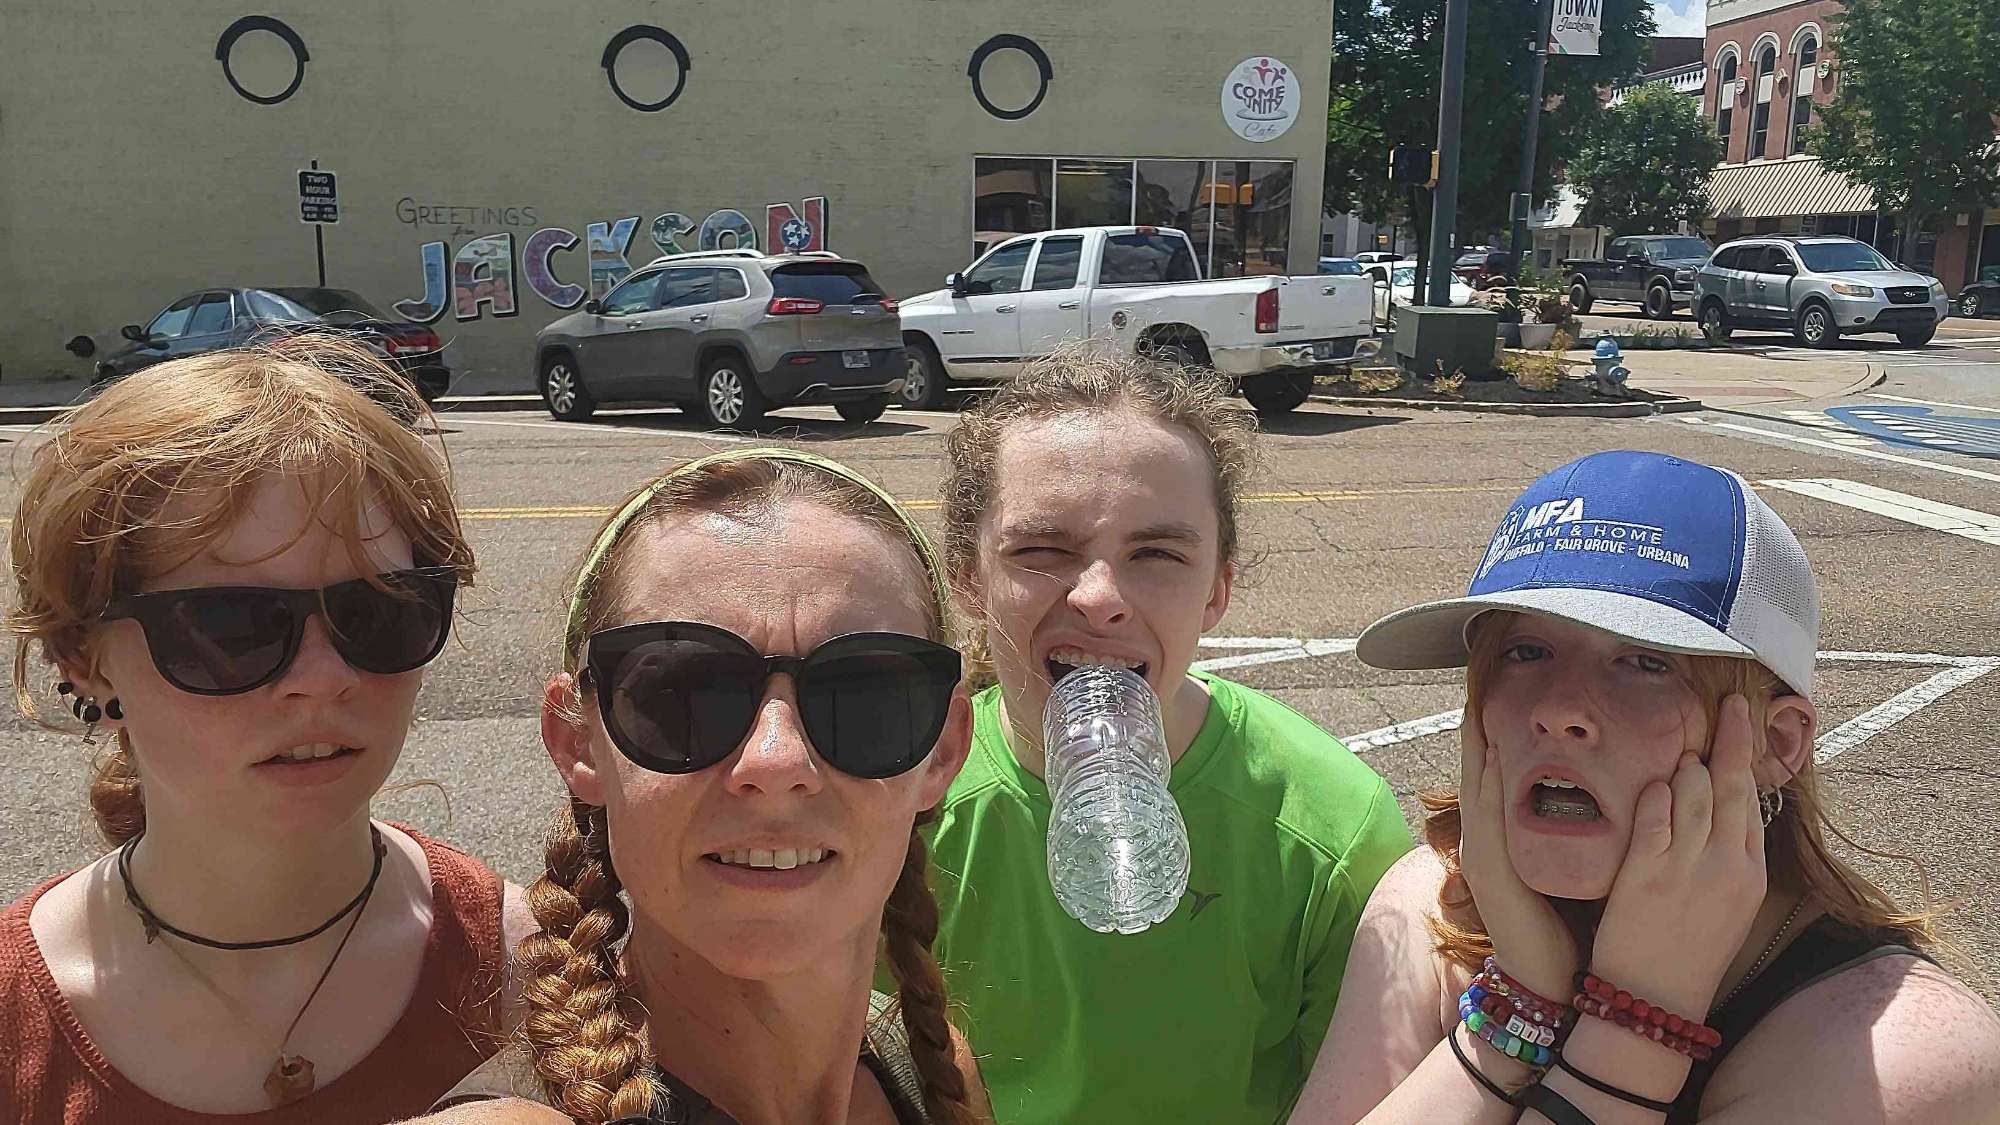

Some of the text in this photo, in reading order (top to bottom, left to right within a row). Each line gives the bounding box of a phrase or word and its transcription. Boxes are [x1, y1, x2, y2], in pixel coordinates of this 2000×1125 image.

[1557, 17, 1595, 33] Jackson
[1233, 83, 1285, 100] COME
[1244, 97, 1284, 114] UNITY
[1243, 122, 1280, 137] Caf
[306, 175, 328, 184] TWO
[305, 185, 330, 194] HOUR
[396, 197, 537, 228] GREETINGS
[392, 196, 828, 325] JACKSON
[1520, 497, 1584, 532] MFA
[1514, 525, 1664, 546] FARM & HOME
[1503, 541, 1545, 562] BUFFALO
[1554, 539, 1582, 551] FAIR
[1637, 545, 1690, 570] URBANA
